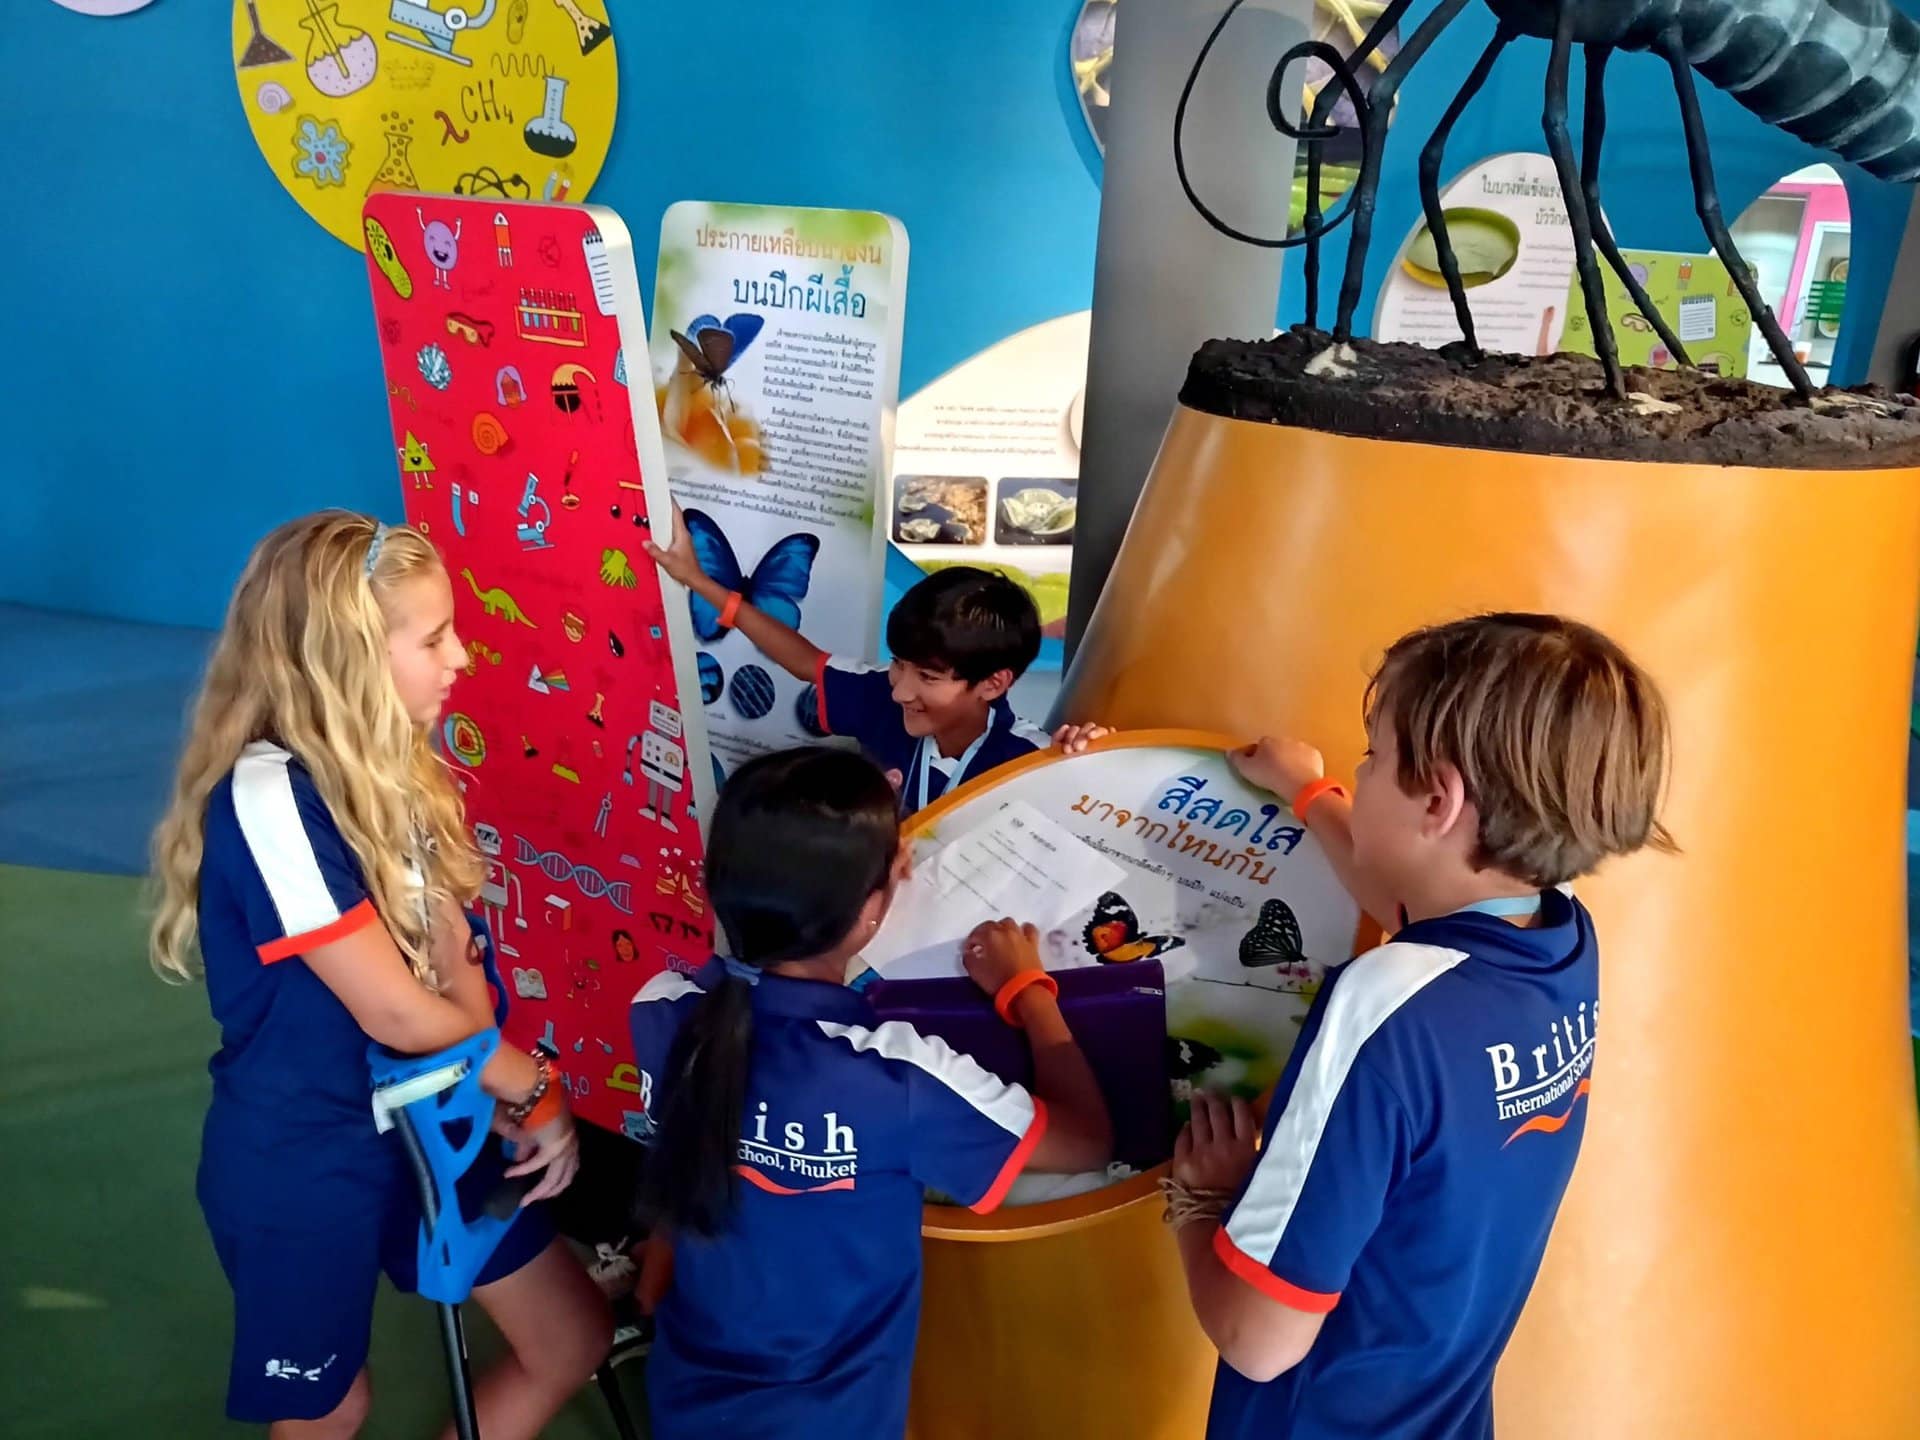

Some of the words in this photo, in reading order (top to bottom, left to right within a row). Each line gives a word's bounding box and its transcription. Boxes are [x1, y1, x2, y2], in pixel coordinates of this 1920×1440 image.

[695, 223, 883, 265] ประกายเหลือบนเงน
[732, 263, 867, 319] บนปีกผีเสื้อ
[1070, 794, 1277, 885] มาจากไหนกัน
[1157, 775, 1306, 856] สีสดใส
[1496, 1066, 1575, 1121] International
[737, 1145, 785, 1170] chool,
[789, 1157, 858, 1179] Phuket
